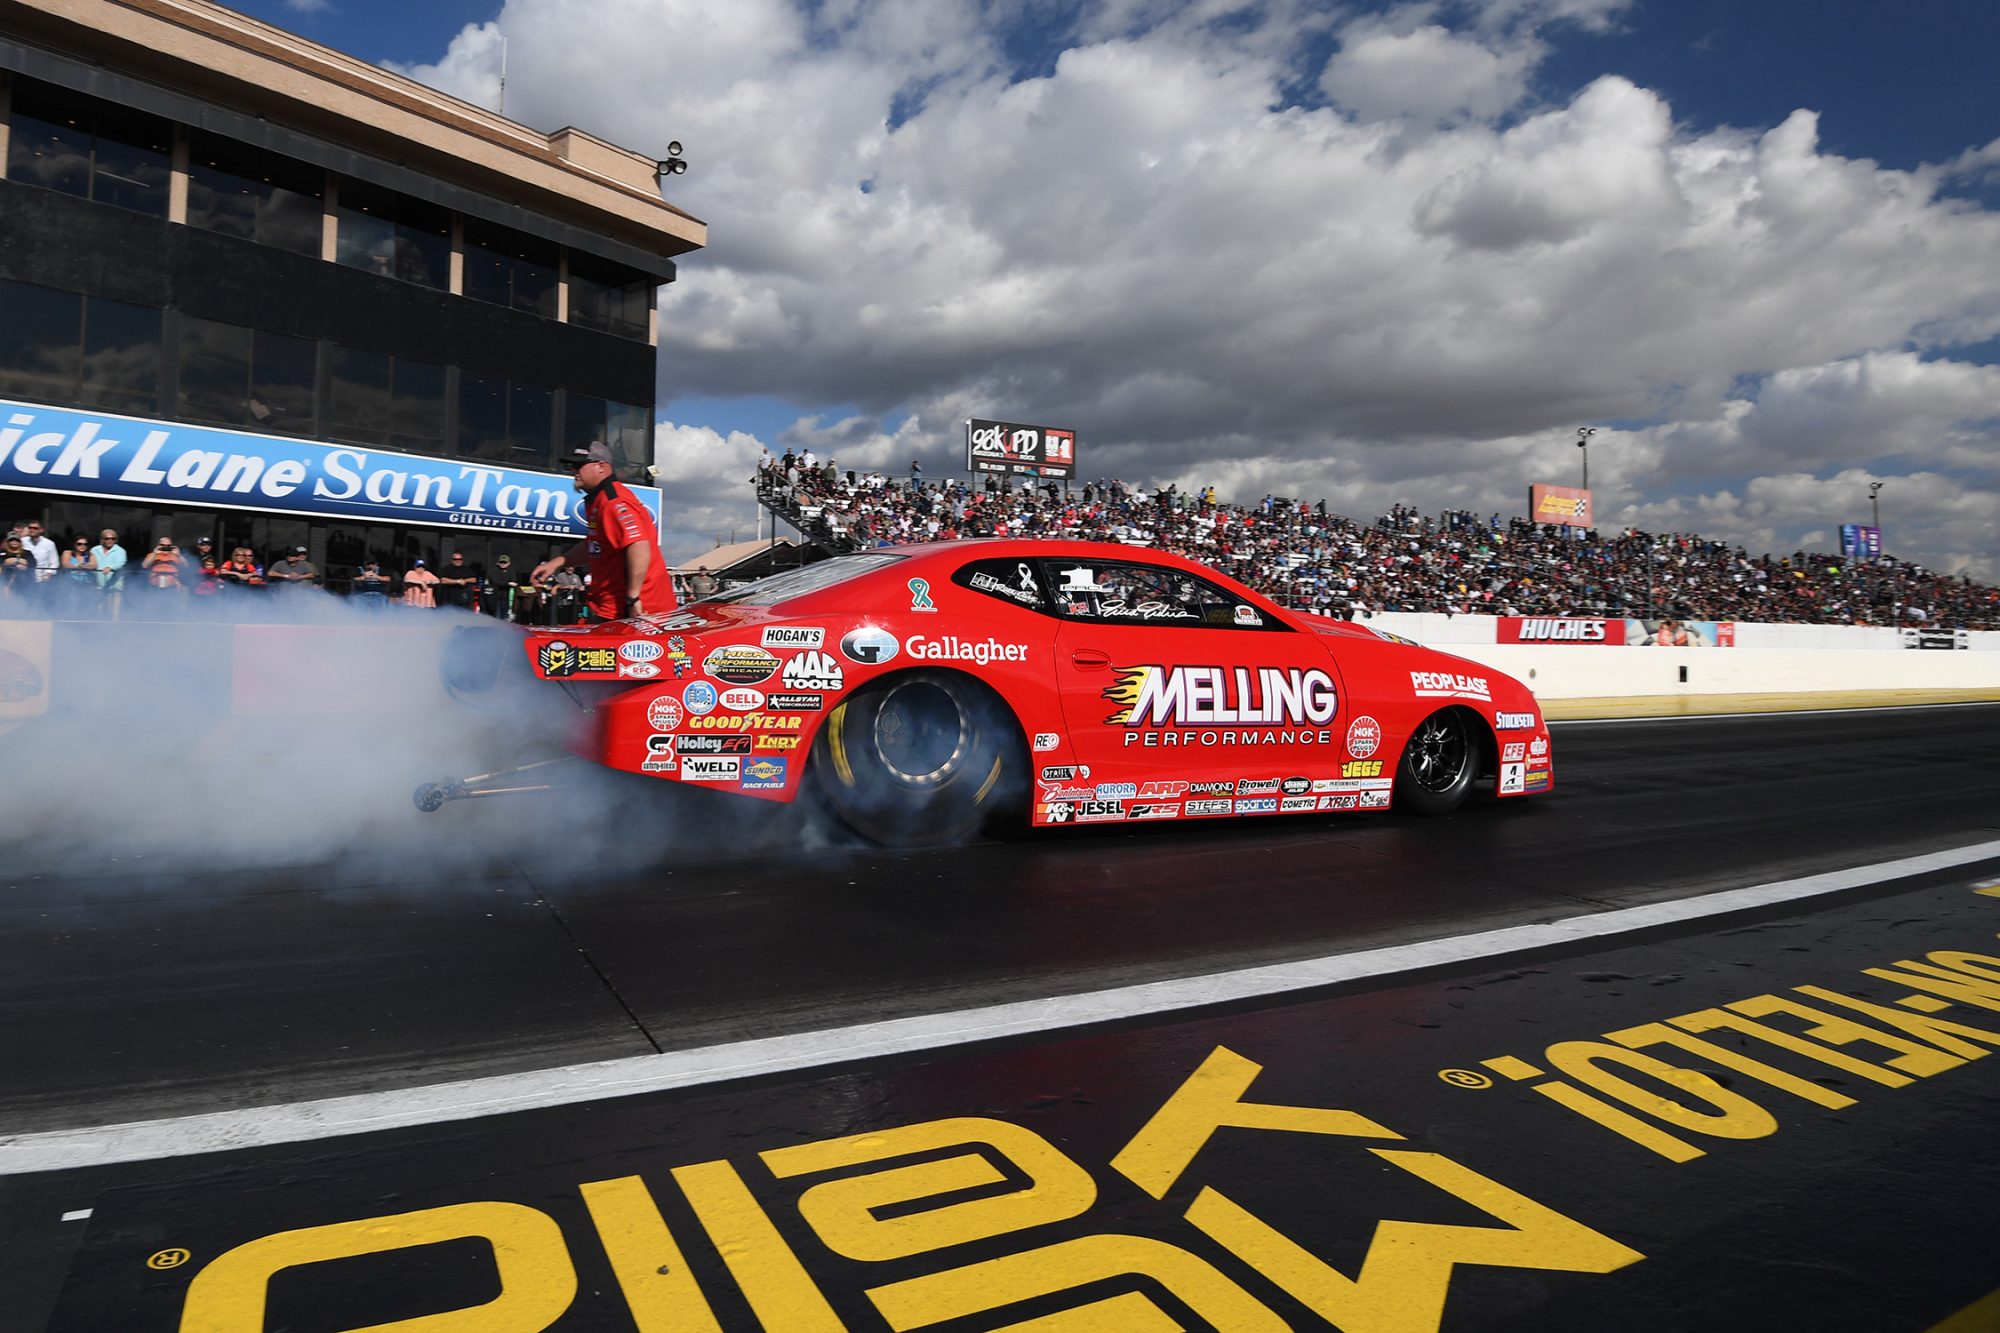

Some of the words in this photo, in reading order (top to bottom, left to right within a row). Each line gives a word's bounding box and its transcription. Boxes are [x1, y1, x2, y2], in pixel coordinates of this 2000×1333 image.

[119, 430, 308, 498] Lane
[449, 513, 507, 528] Gilbert
[514, 519, 571, 533] Arizona
[766, 629, 820, 642] HOGAN'S
[1518, 619, 1606, 640] HUGHES
[578, 650, 615, 660] Mello
[625, 645, 657, 658] NHRA
[724, 649, 765, 658] HIGH
[905, 635, 1028, 665] Gallagher
[578, 657, 615, 667] Yello
[706, 658, 778, 667] PERFORMANCE
[782, 650, 843, 679] MAC
[782, 678, 843, 691] TOOLS
[1410, 671, 1491, 695] PEOPLEASE
[725, 693, 758, 704] BELL
[777, 695, 821, 703] ALLSTAR
[1126, 665, 1338, 727] MELLING
[654, 705, 677, 714] NGK
[1124, 730, 1332, 747] PERFORMANCE
[1354, 727, 1375, 738] NGK
[677, 735, 722, 753] Holley
[754, 734, 802, 749] INDY
[694, 761, 739, 773] WELD
[744, 766, 783, 775] SUNOCO
[1341, 761, 1383, 778] JEGS
[1096, 784, 1136, 795] AURORA
[1140, 782, 1188, 796] ARP
[1190, 783, 1234, 792] DIAMOND
[1239, 778, 1279, 789] Browell
[1077, 801, 1124, 815] JESEL
[1187, 801, 1229, 810] STEF'S
[1234, 799, 1277, 812] sparco
[1282, 799, 1315, 808] COMETIC
